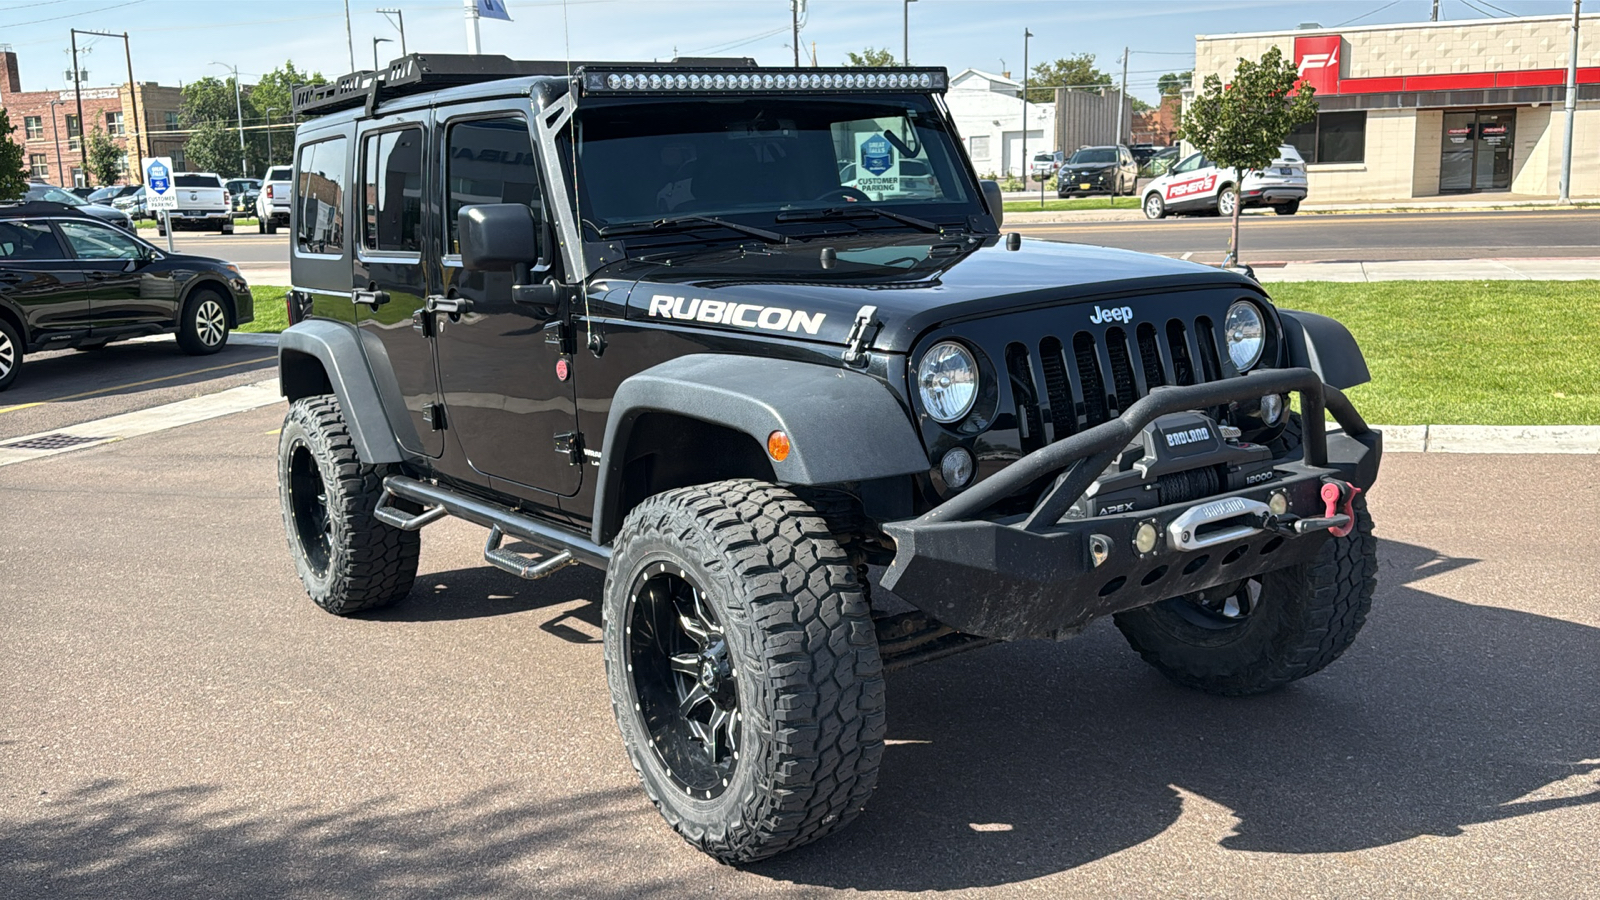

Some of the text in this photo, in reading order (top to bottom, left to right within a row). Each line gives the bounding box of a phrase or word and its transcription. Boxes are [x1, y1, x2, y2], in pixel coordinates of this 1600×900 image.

[858, 177, 898, 185] CUSTOMER
[862, 184, 894, 192] PARKING
[648, 295, 826, 335] RUBICON
[1090, 305, 1133, 324] Jeep
[1166, 427, 1210, 447] BADLAND
[1246, 471, 1273, 484] 12000
[1099, 502, 1134, 516] APEX
